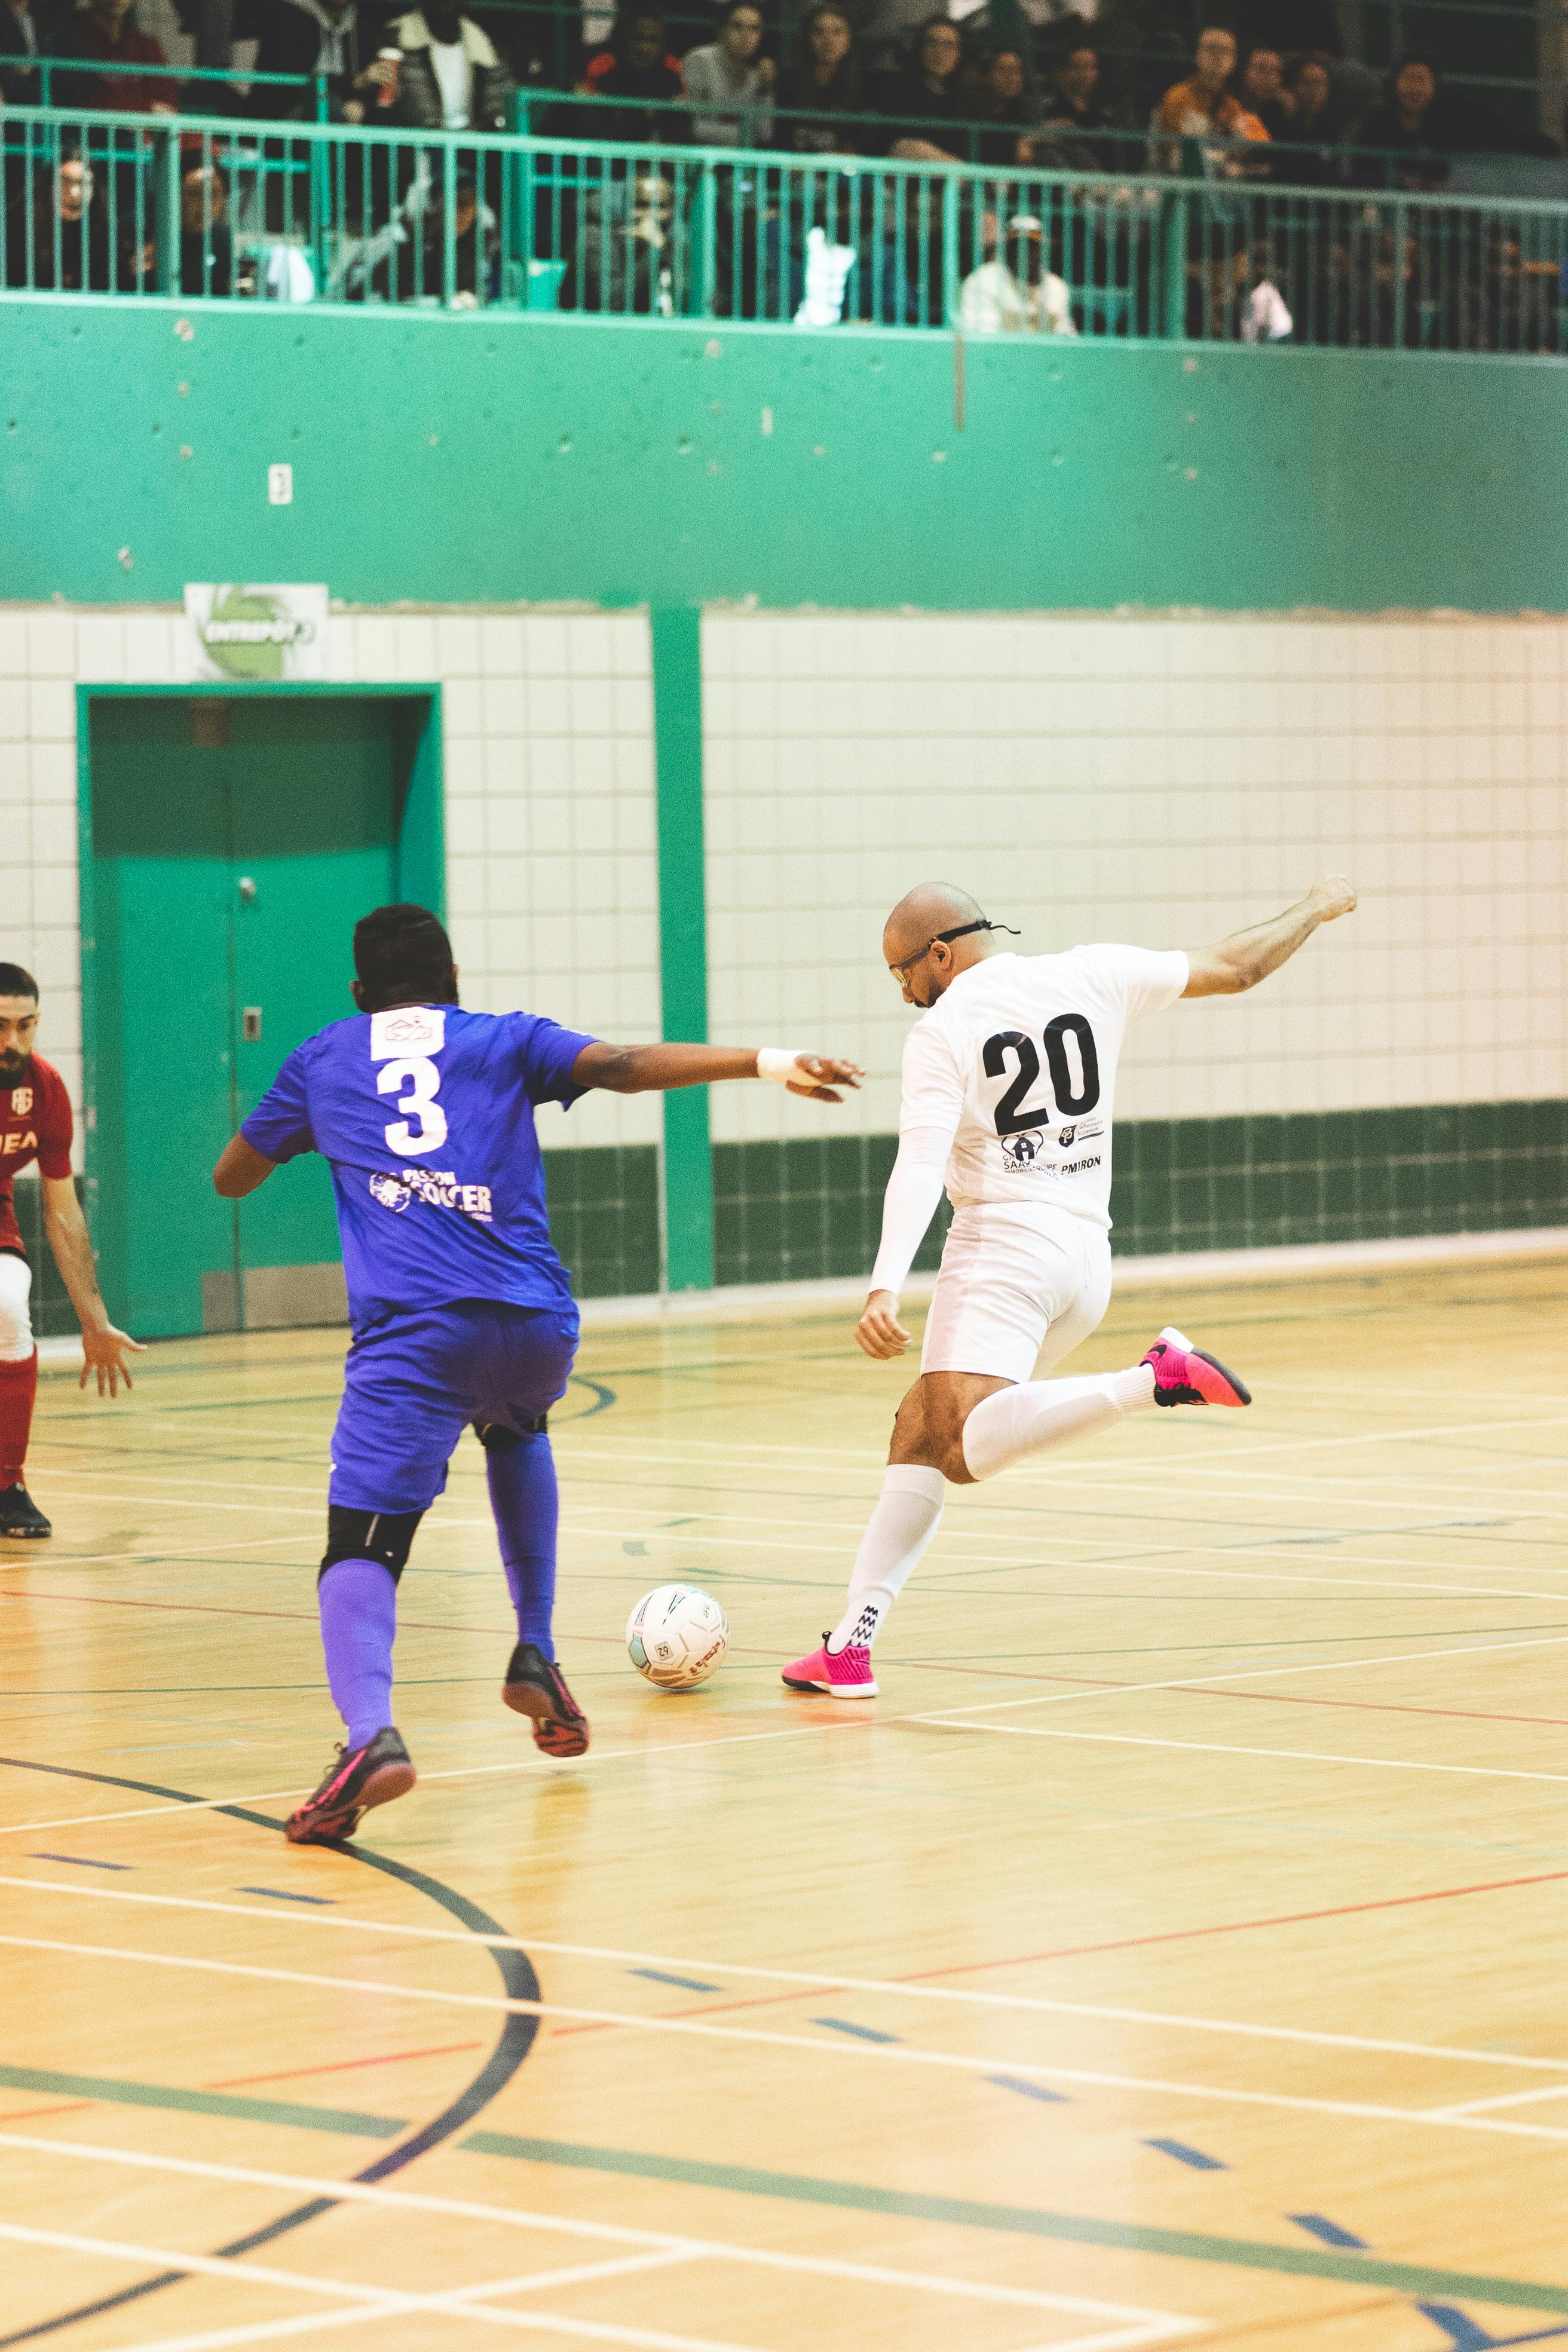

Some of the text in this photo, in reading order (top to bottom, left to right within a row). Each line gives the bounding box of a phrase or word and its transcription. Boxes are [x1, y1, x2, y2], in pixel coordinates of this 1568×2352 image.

[982, 1013, 1100, 1136] 20
[376, 1056, 448, 1156] 3
[0, 1131, 38, 1156] EA
[1061, 1155, 1101, 1175] PMIRON
[409, 1181, 492, 1213] SOCCER
[657, 1645, 669, 1657] 62
